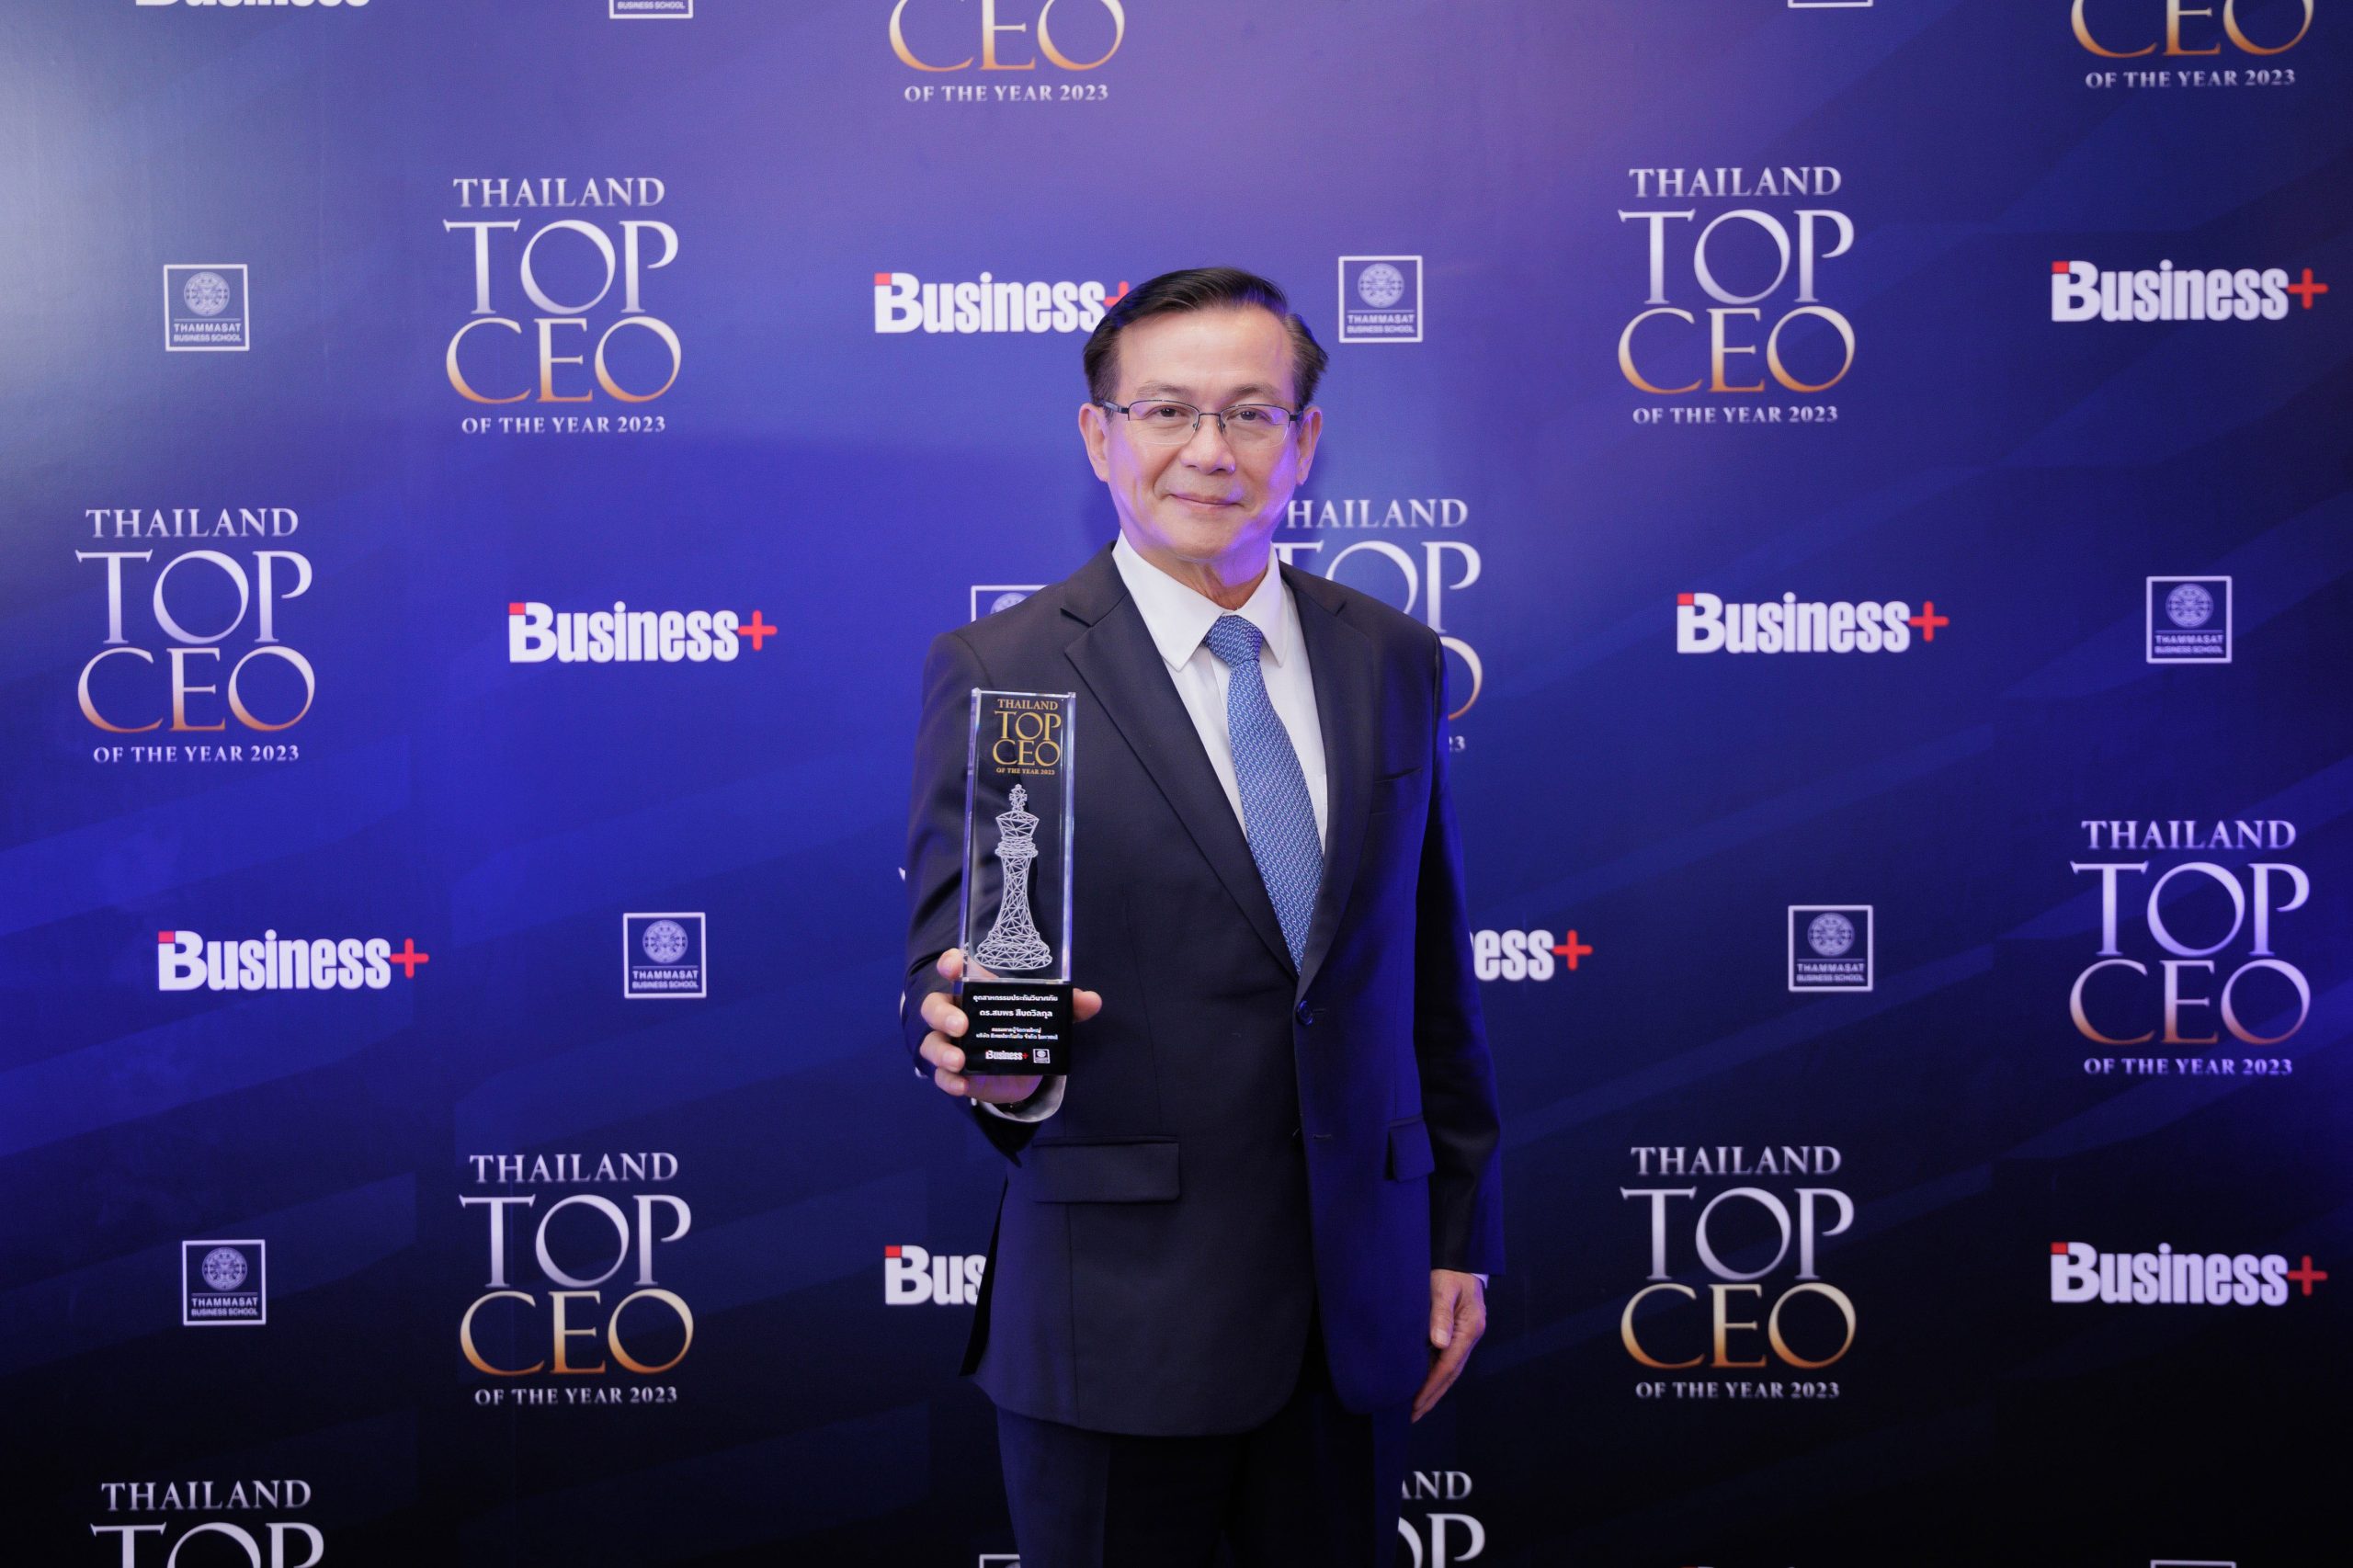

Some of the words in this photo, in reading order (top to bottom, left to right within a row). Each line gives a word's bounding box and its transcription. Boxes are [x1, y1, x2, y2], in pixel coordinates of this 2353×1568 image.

[889, 0, 1125, 72] CEO
[904, 85, 935, 102] OF
[940, 85, 987, 102] THE
[994, 85, 1052, 101] YEAR
[1060, 84, 1108, 101] 2023
[2085, 71, 2118, 87] OF
[2121, 70, 2171, 87] THE
[2177, 70, 2237, 86] YEAR
[2245, 68, 2295, 85] 2023
[452, 177, 665, 208] THAILAND
[1628, 166, 1842, 198] THAILAND
[442, 219, 679, 314] TOP
[1617, 208, 1855, 305] TOP
[174, 323, 242, 333] THAMMASAT
[446, 315, 682, 403] CEO
[1618, 305, 1856, 394] CEO
[461, 417, 492, 434] OF
[498, 416, 545, 433] THE
[551, 416, 609, 433] YEAR
[617, 415, 665, 433] 2023
[1632, 407, 1664, 425] OF
[1669, 407, 1716, 424] THE
[1722, 406, 1781, 423] YEAR
[1789, 405, 1838, 423] 2023
[85, 507, 299, 538] THAILAND
[74, 549, 313, 644] TOP
[77, 645, 315, 732] CEO
[997, 699, 1059, 710] THAILAND
[994, 710, 1062, 741] TOP
[93, 746, 123, 763] OF
[131, 745, 176, 763] THE
[184, 745, 243, 762] YEAR
[251, 744, 300, 761] 2023
[993, 739, 1061, 767] CEO
[2081, 820, 2296, 849] THAILAND
[2070, 860, 2310, 957] TOP
[632, 970, 699, 980] THAMMASAT
[2069, 959, 2311, 1043] CEO
[2084, 1058, 2114, 1074] OF
[2121, 1058, 2168, 1074] THE
[2175, 1058, 2234, 1074] YEAR
[2243, 1058, 2292, 1074] 2023
[469, 1152, 678, 1183] THAILAND
[1631, 1145, 1841, 1175] THAILAND
[459, 1194, 692, 1292] TOP
[1620, 1187, 1855, 1286] TOP
[191, 1297, 258, 1307] THAMMASAT
[460, 1290, 694, 1374] CEO
[1620, 1284, 1857, 1368] CEO
[474, 1389, 505, 1405] OF
[511, 1388, 558, 1404] THE
[565, 1387, 622, 1403] YEAR
[630, 1386, 677, 1403] 2023
[1635, 1381, 1665, 1398] OF
[1672, 1381, 1718, 1398] THE
[1725, 1381, 1783, 1398] YEAR
[1791, 1381, 1839, 1398] 2023
[101, 1479, 312, 1511] THAILAND
